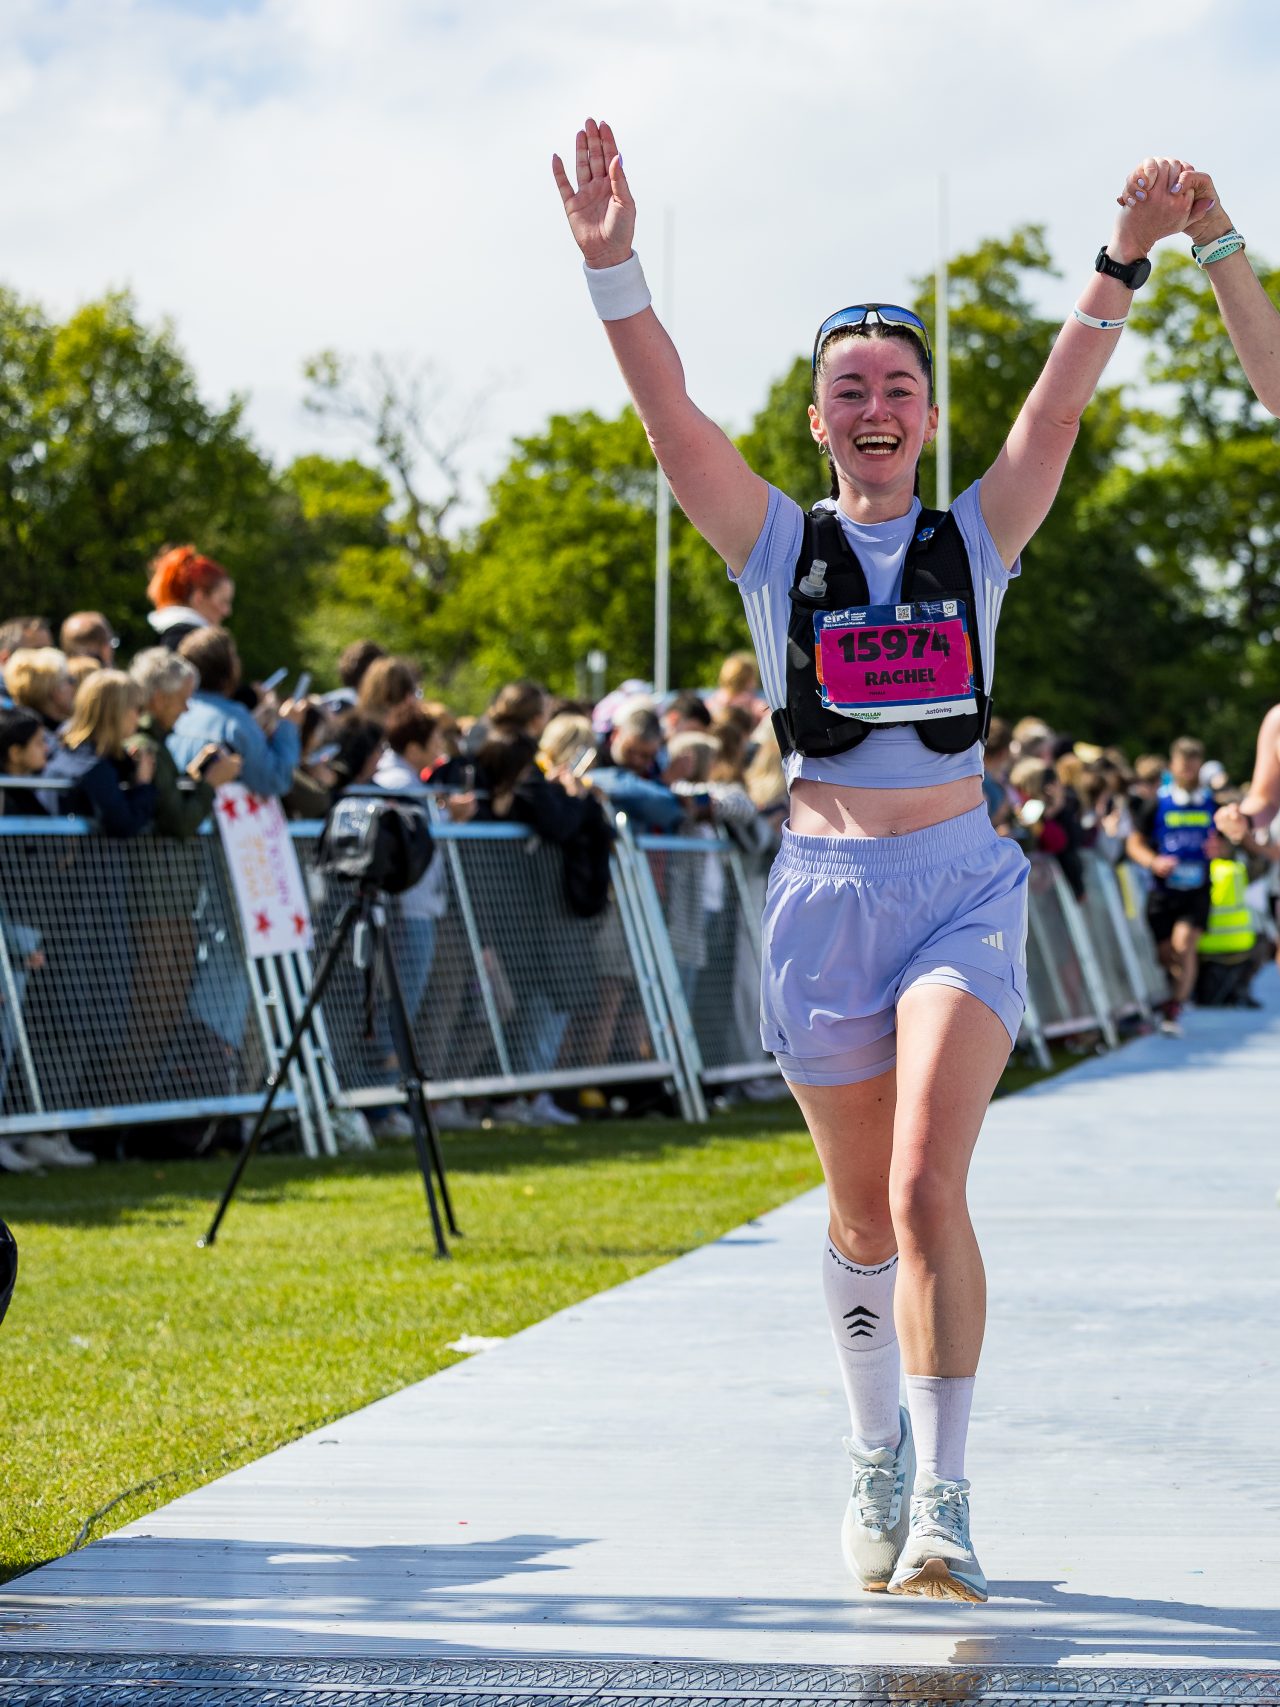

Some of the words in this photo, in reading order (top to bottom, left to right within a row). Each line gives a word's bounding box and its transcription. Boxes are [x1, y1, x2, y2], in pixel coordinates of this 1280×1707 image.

[838, 628, 951, 664] 15974
[865, 668, 936, 687] RACHEL
[925, 707, 952, 715] JustGiving
